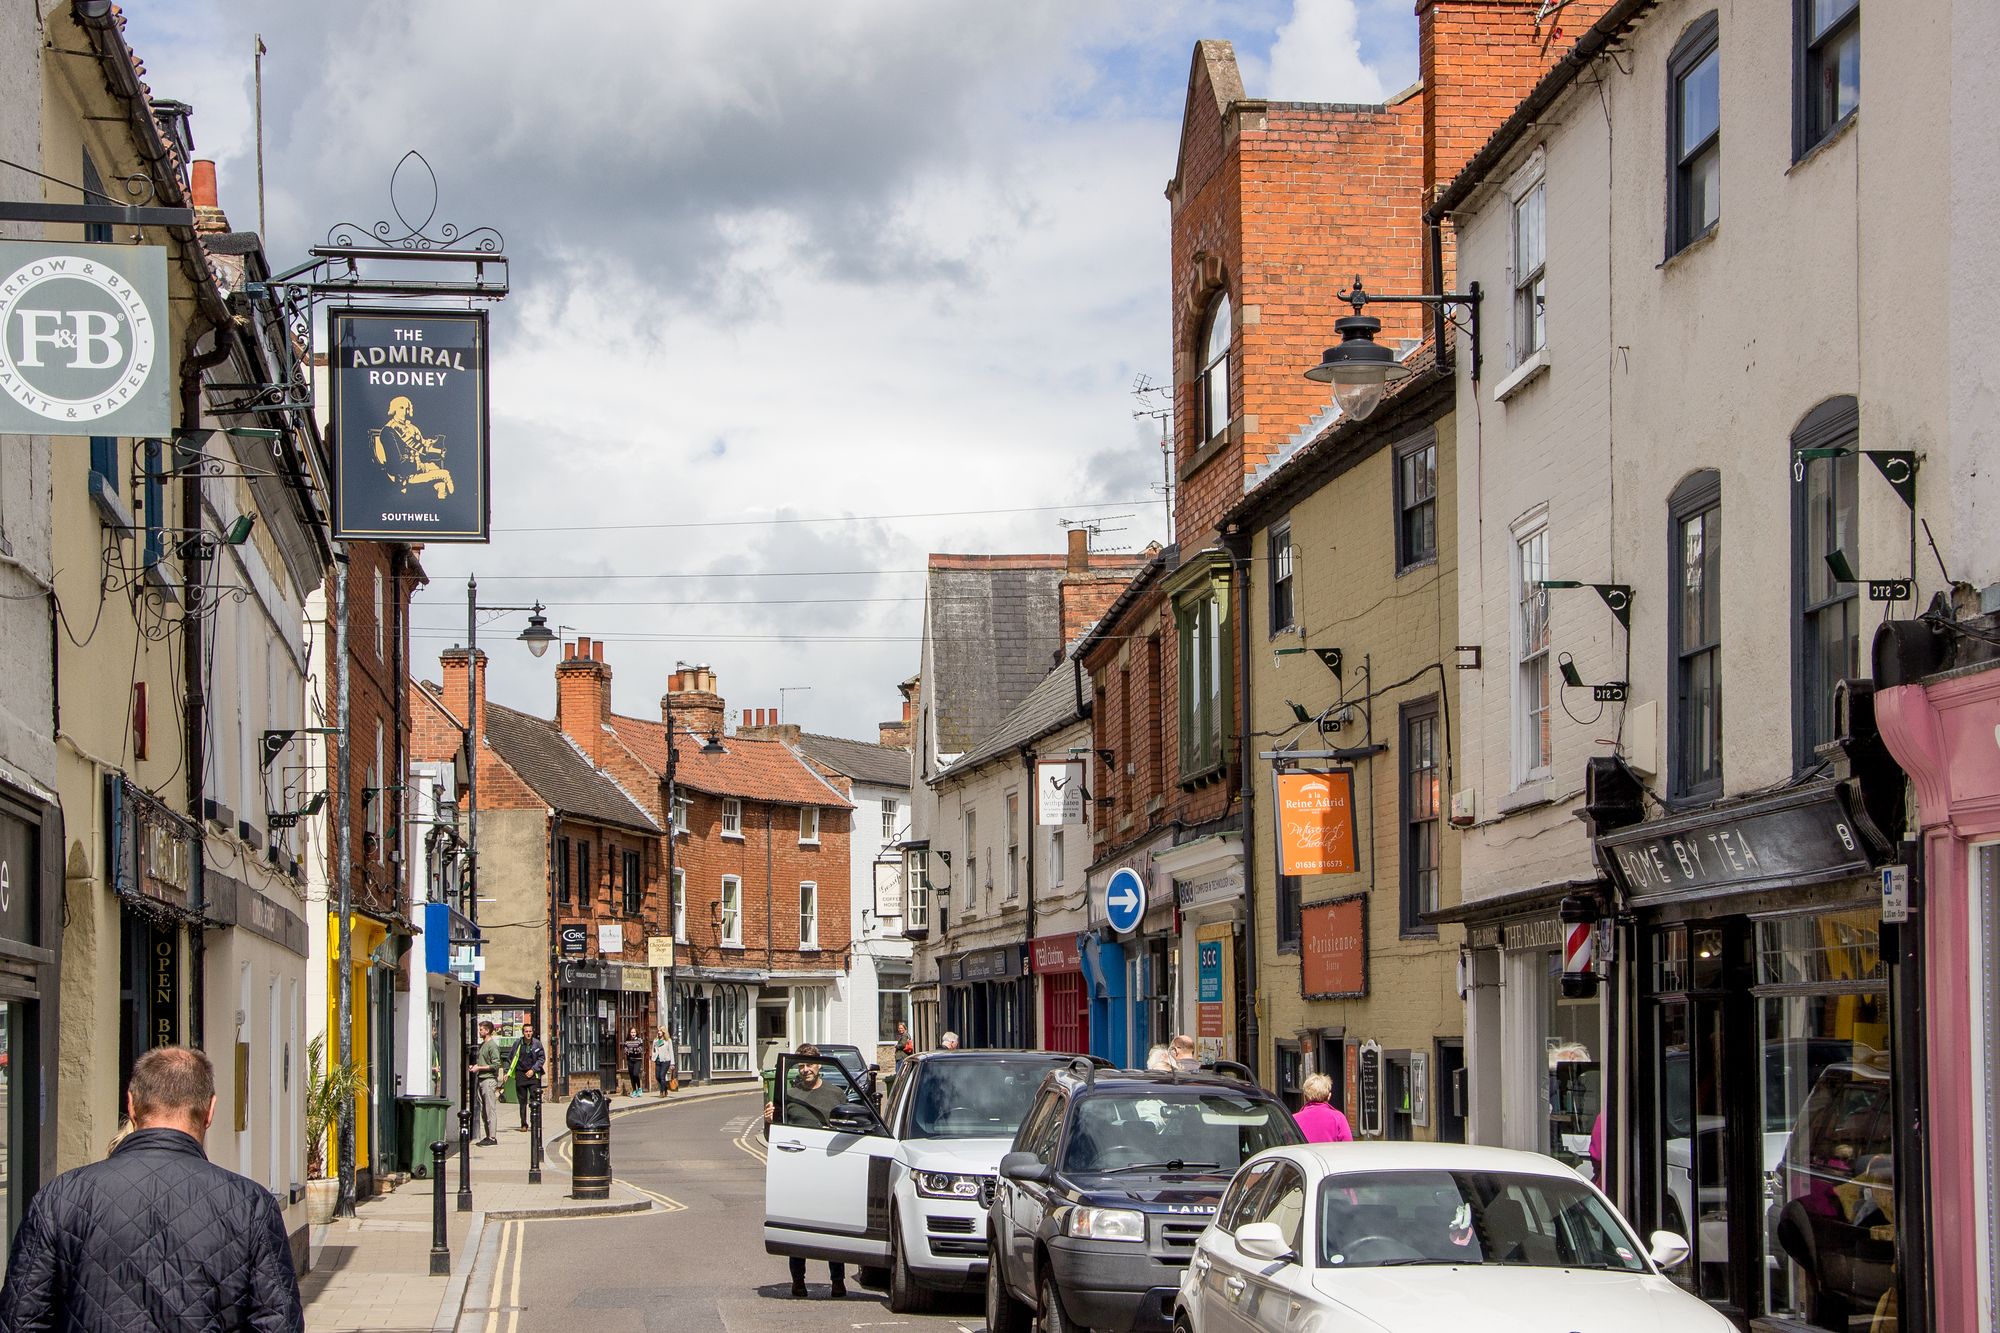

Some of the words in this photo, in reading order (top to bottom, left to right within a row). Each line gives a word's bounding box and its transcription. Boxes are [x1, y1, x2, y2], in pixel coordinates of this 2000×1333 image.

[0, 260, 66, 311] ARROW
[82, 263, 94, 275] &
[107, 275, 147, 327] BALL
[394, 329, 422, 341] THE
[352, 345, 465, 371] ADMIRAL
[369, 371, 447, 386] RODNEY
[66, 407, 77, 418] &
[93, 362, 148, 414] PAPER
[381, 513, 440, 522] SOUTHWELL
[1044, 789, 1079, 800] MOVE
[1286, 799, 1313, 809] Reine
[1315, 797, 1344, 808] Astrid
[1295, 861, 1317, 869] 01636
[1318, 860, 1343, 868] 816573
[1617, 846, 1672, 889] HOME
[1672, 839, 1706, 880] BY
[1707, 829, 1760, 872] TEA
[1504, 925, 1523, 950] THE
[1035, 941, 1047, 967] real
[1201, 949, 1217, 967] SCC
[156, 942, 172, 1003] OPEN
[1168, 1205, 1216, 1213] LAND
